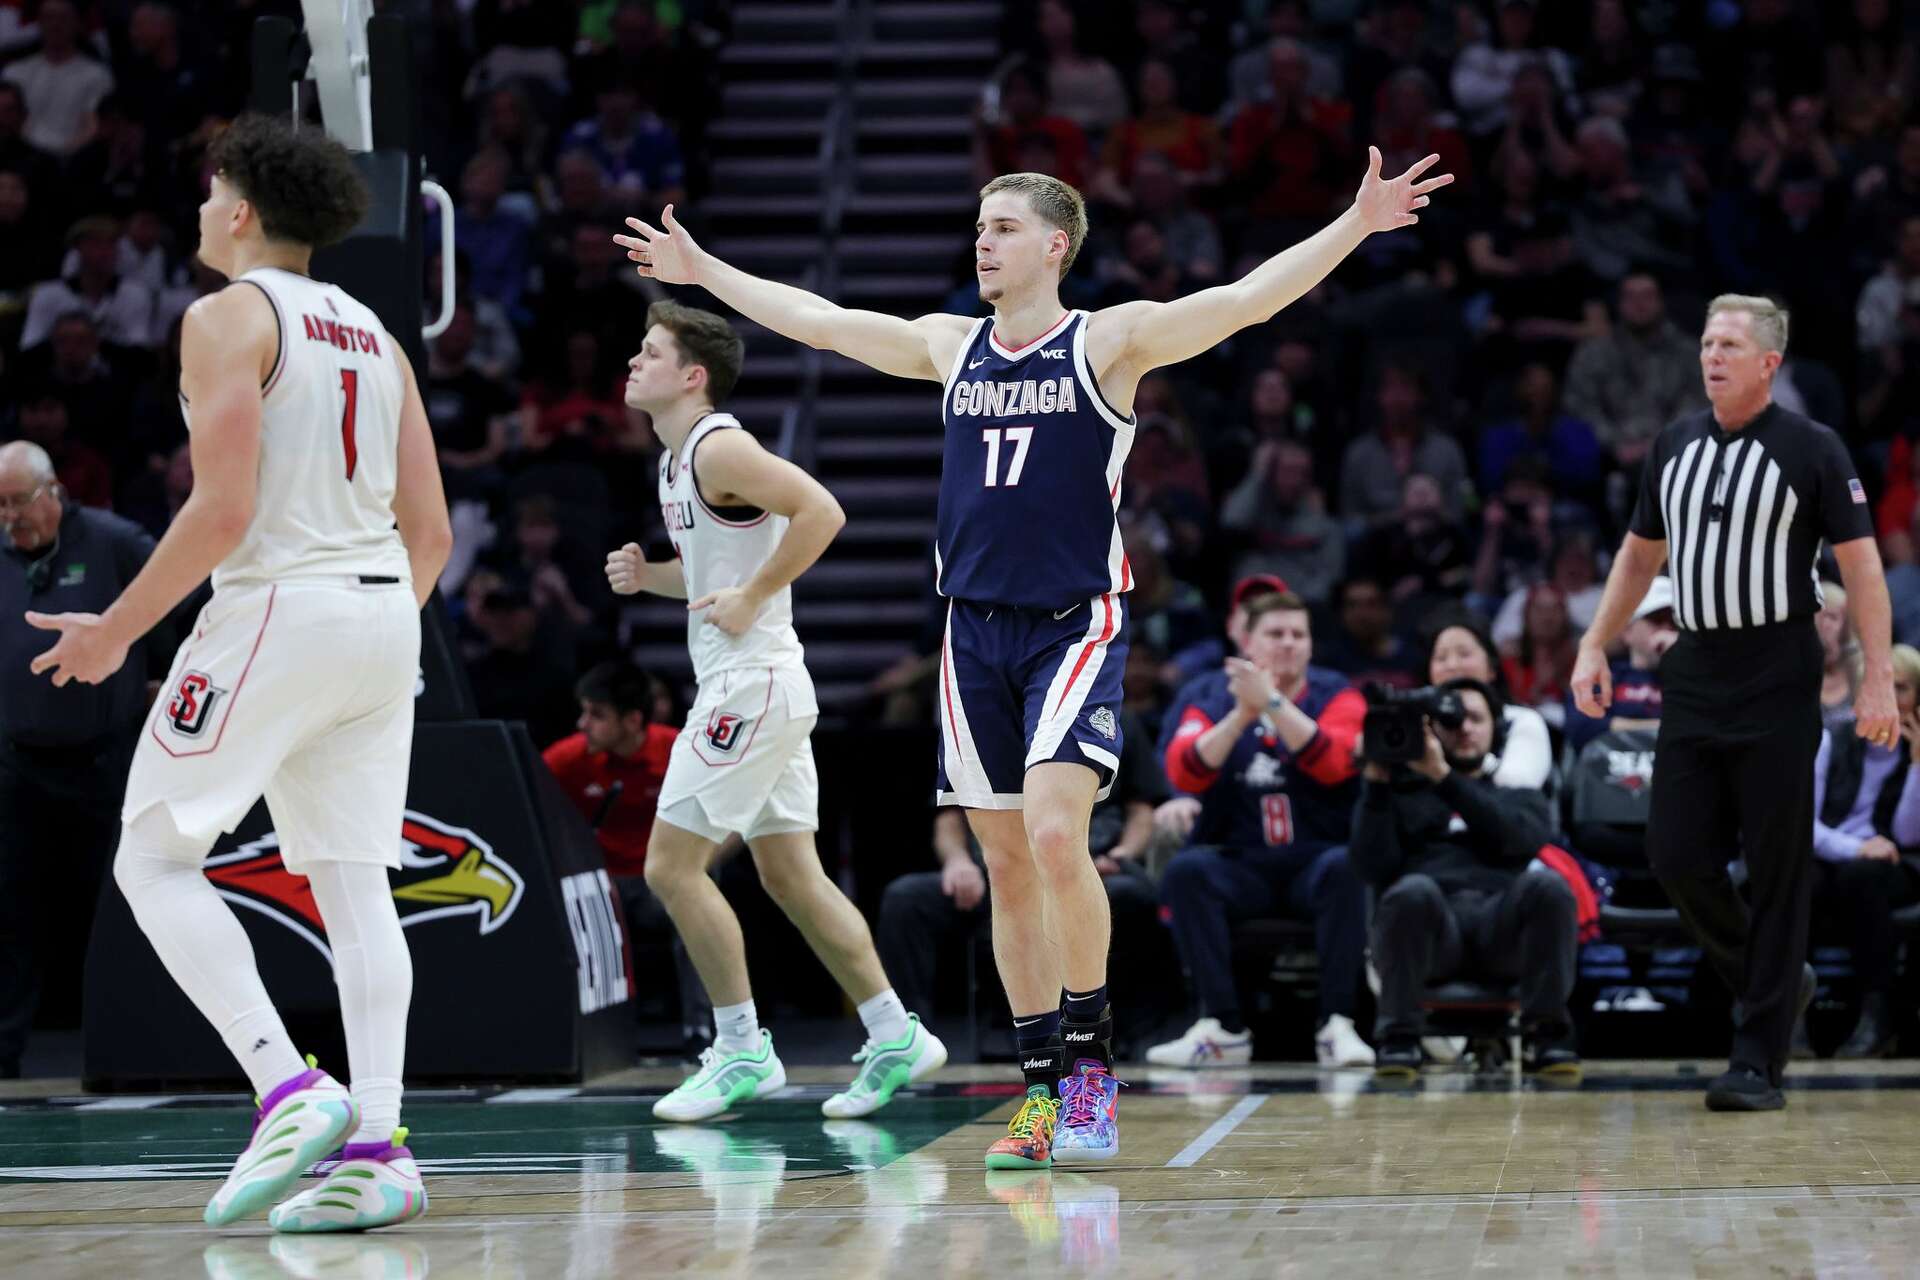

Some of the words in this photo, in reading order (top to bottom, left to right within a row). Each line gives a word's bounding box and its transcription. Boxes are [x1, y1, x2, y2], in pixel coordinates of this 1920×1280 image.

[339, 367, 358, 482] 1
[952, 376, 1077, 417] GONZAGA
[982, 426, 1034, 487] 17
